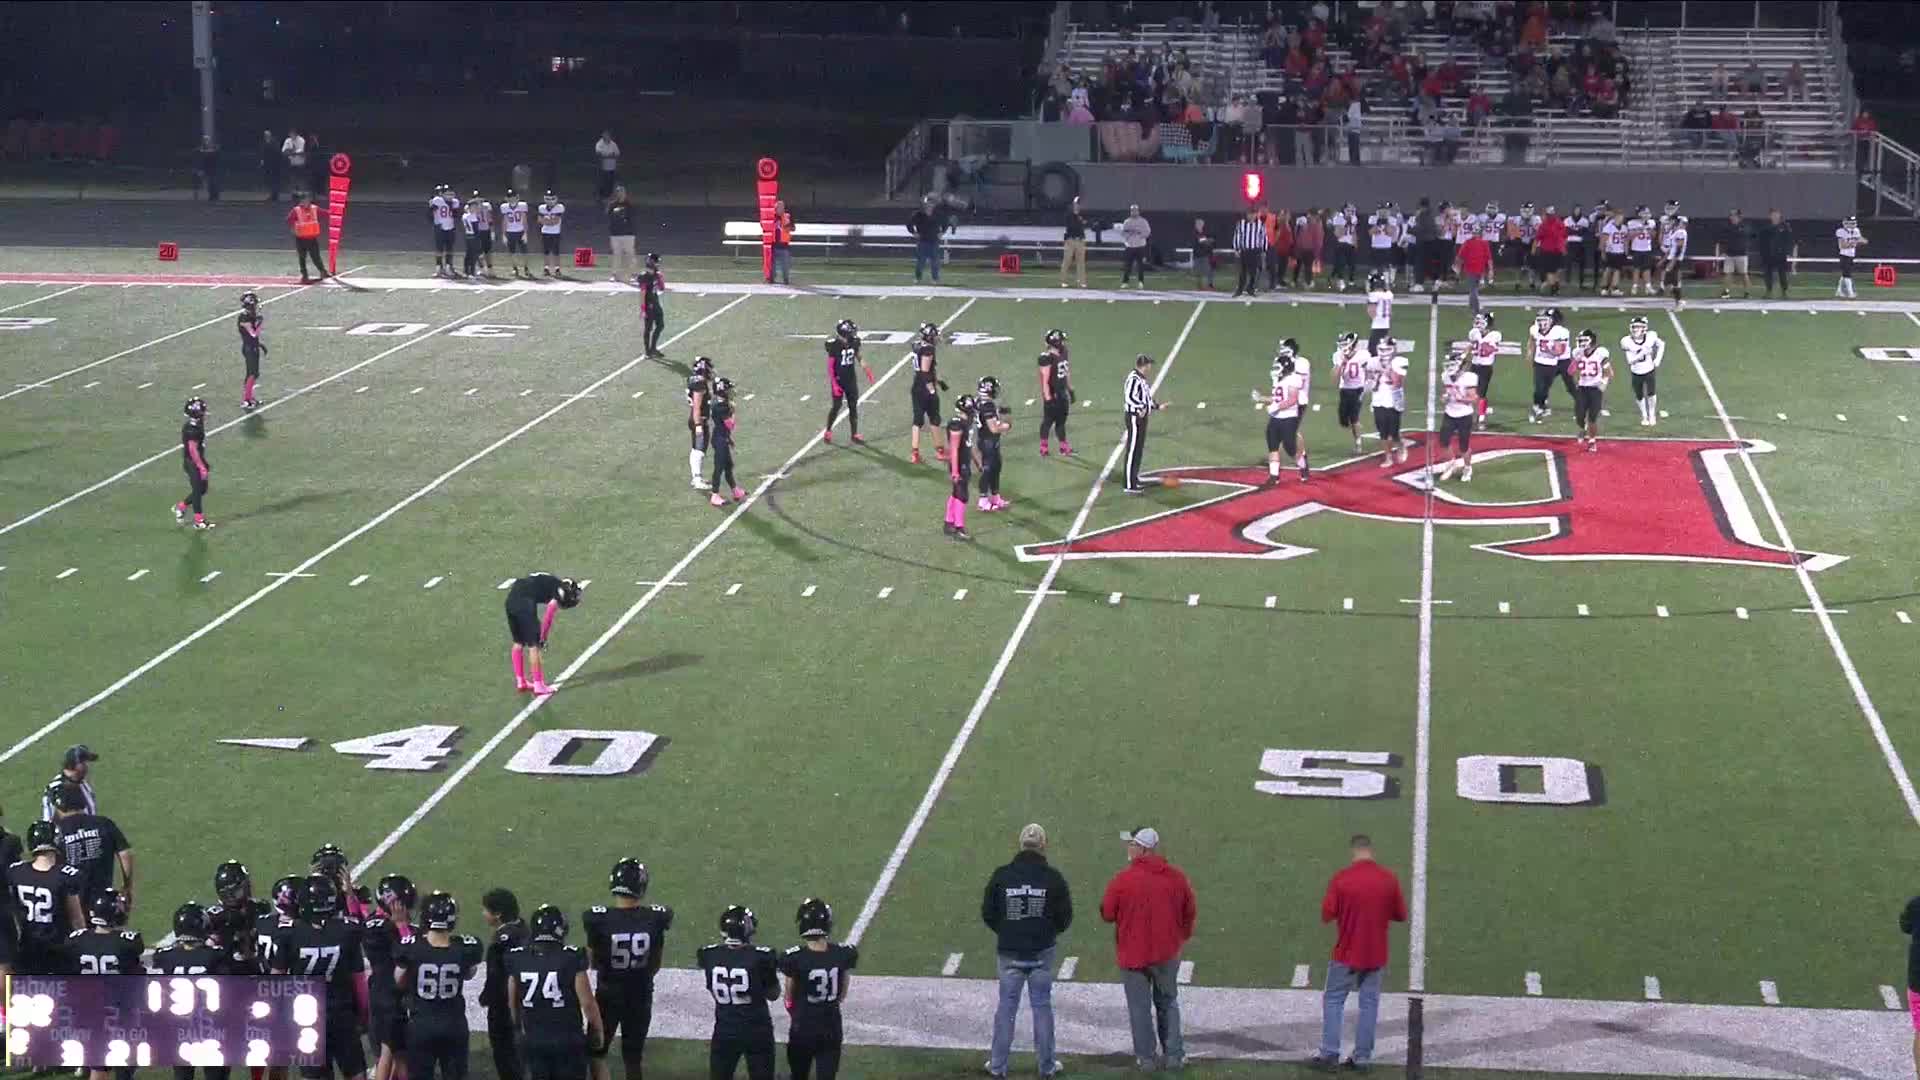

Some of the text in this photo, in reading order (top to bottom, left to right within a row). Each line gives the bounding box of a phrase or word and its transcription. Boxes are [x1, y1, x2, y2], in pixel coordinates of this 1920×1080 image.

[17, 885, 53, 924] 52
[300, 944, 342, 982] 77
[610, 932, 652, 970] 59
[417, 963, 460, 1000] 66
[520, 971, 565, 1008] 74
[711, 966, 752, 1005] 62
[807, 967, 840, 1003] 31
